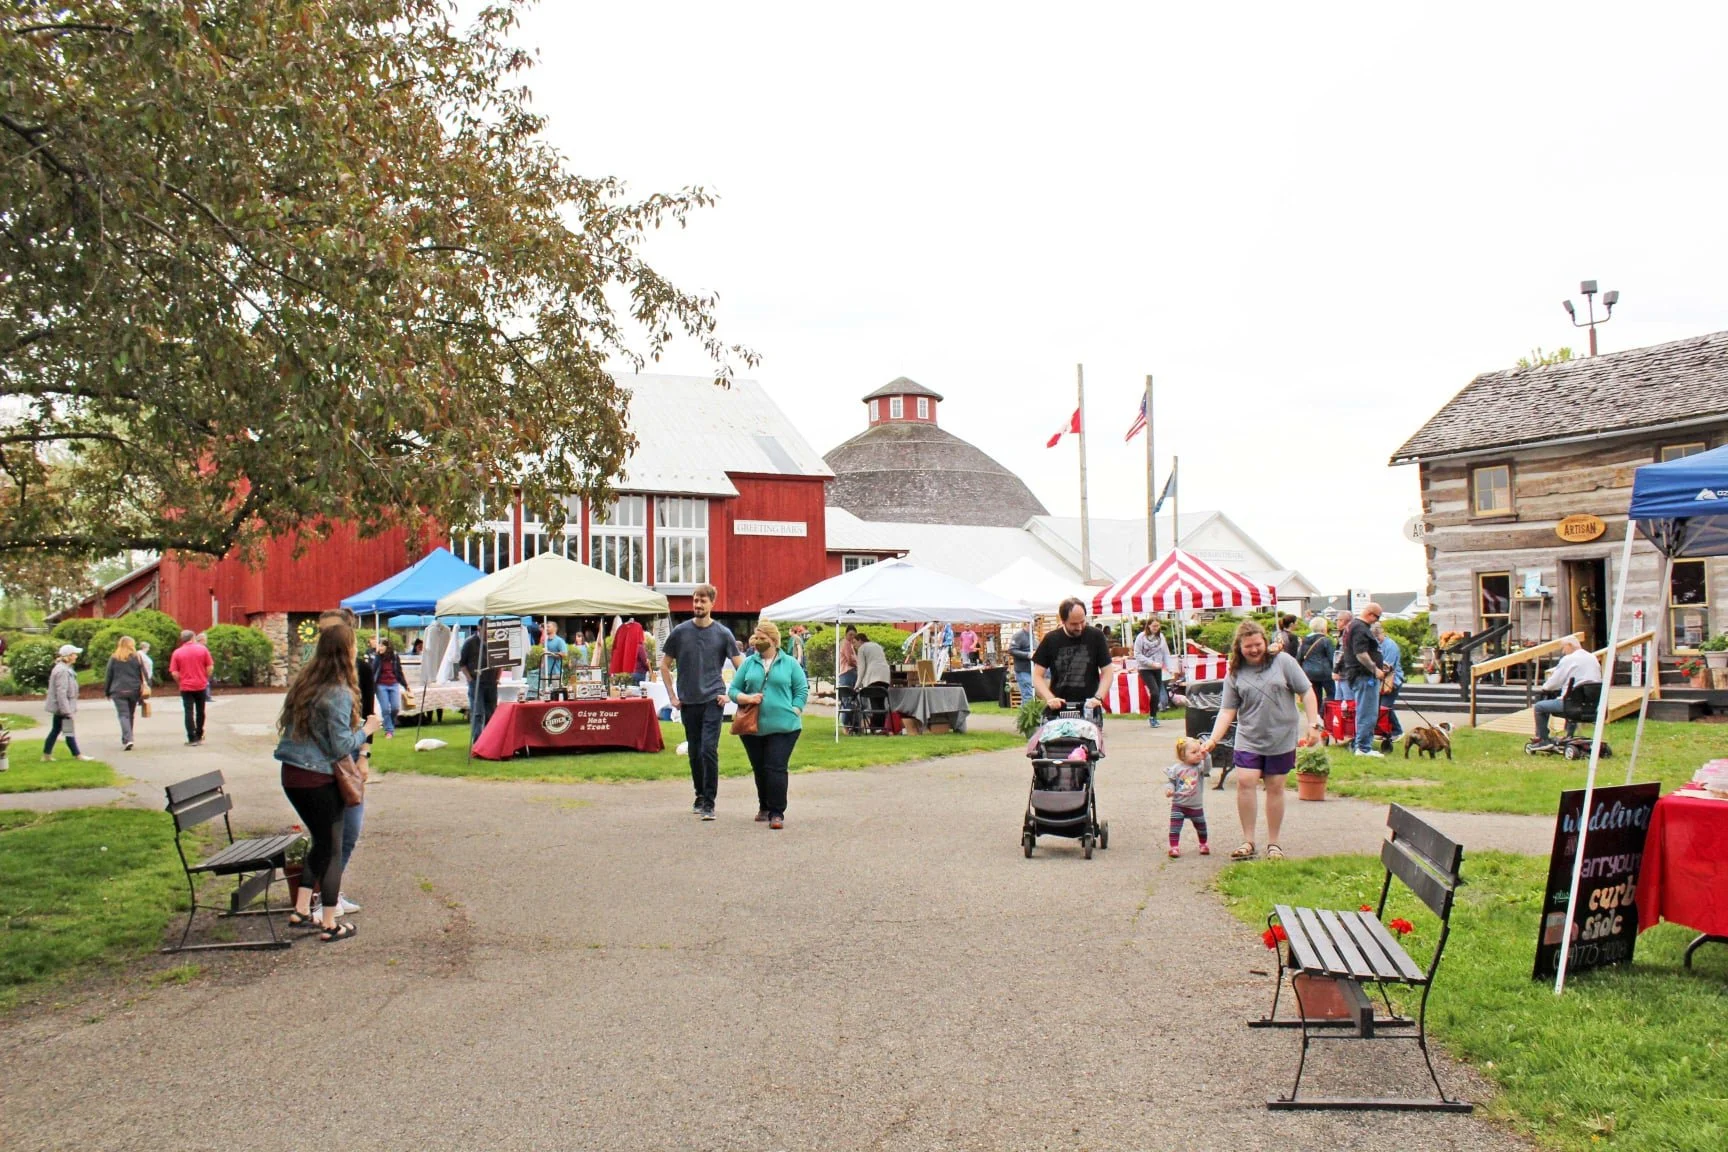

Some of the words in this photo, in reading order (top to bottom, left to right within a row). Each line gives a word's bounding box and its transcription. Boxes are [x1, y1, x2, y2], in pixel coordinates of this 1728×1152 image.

[737, 523, 779, 533] GREETING
[1563, 521, 1597, 536] ARTISAN
[1588, 800, 1651, 832] deliver
[1589, 875, 1636, 911] curb
[1582, 908, 1623, 941] side
